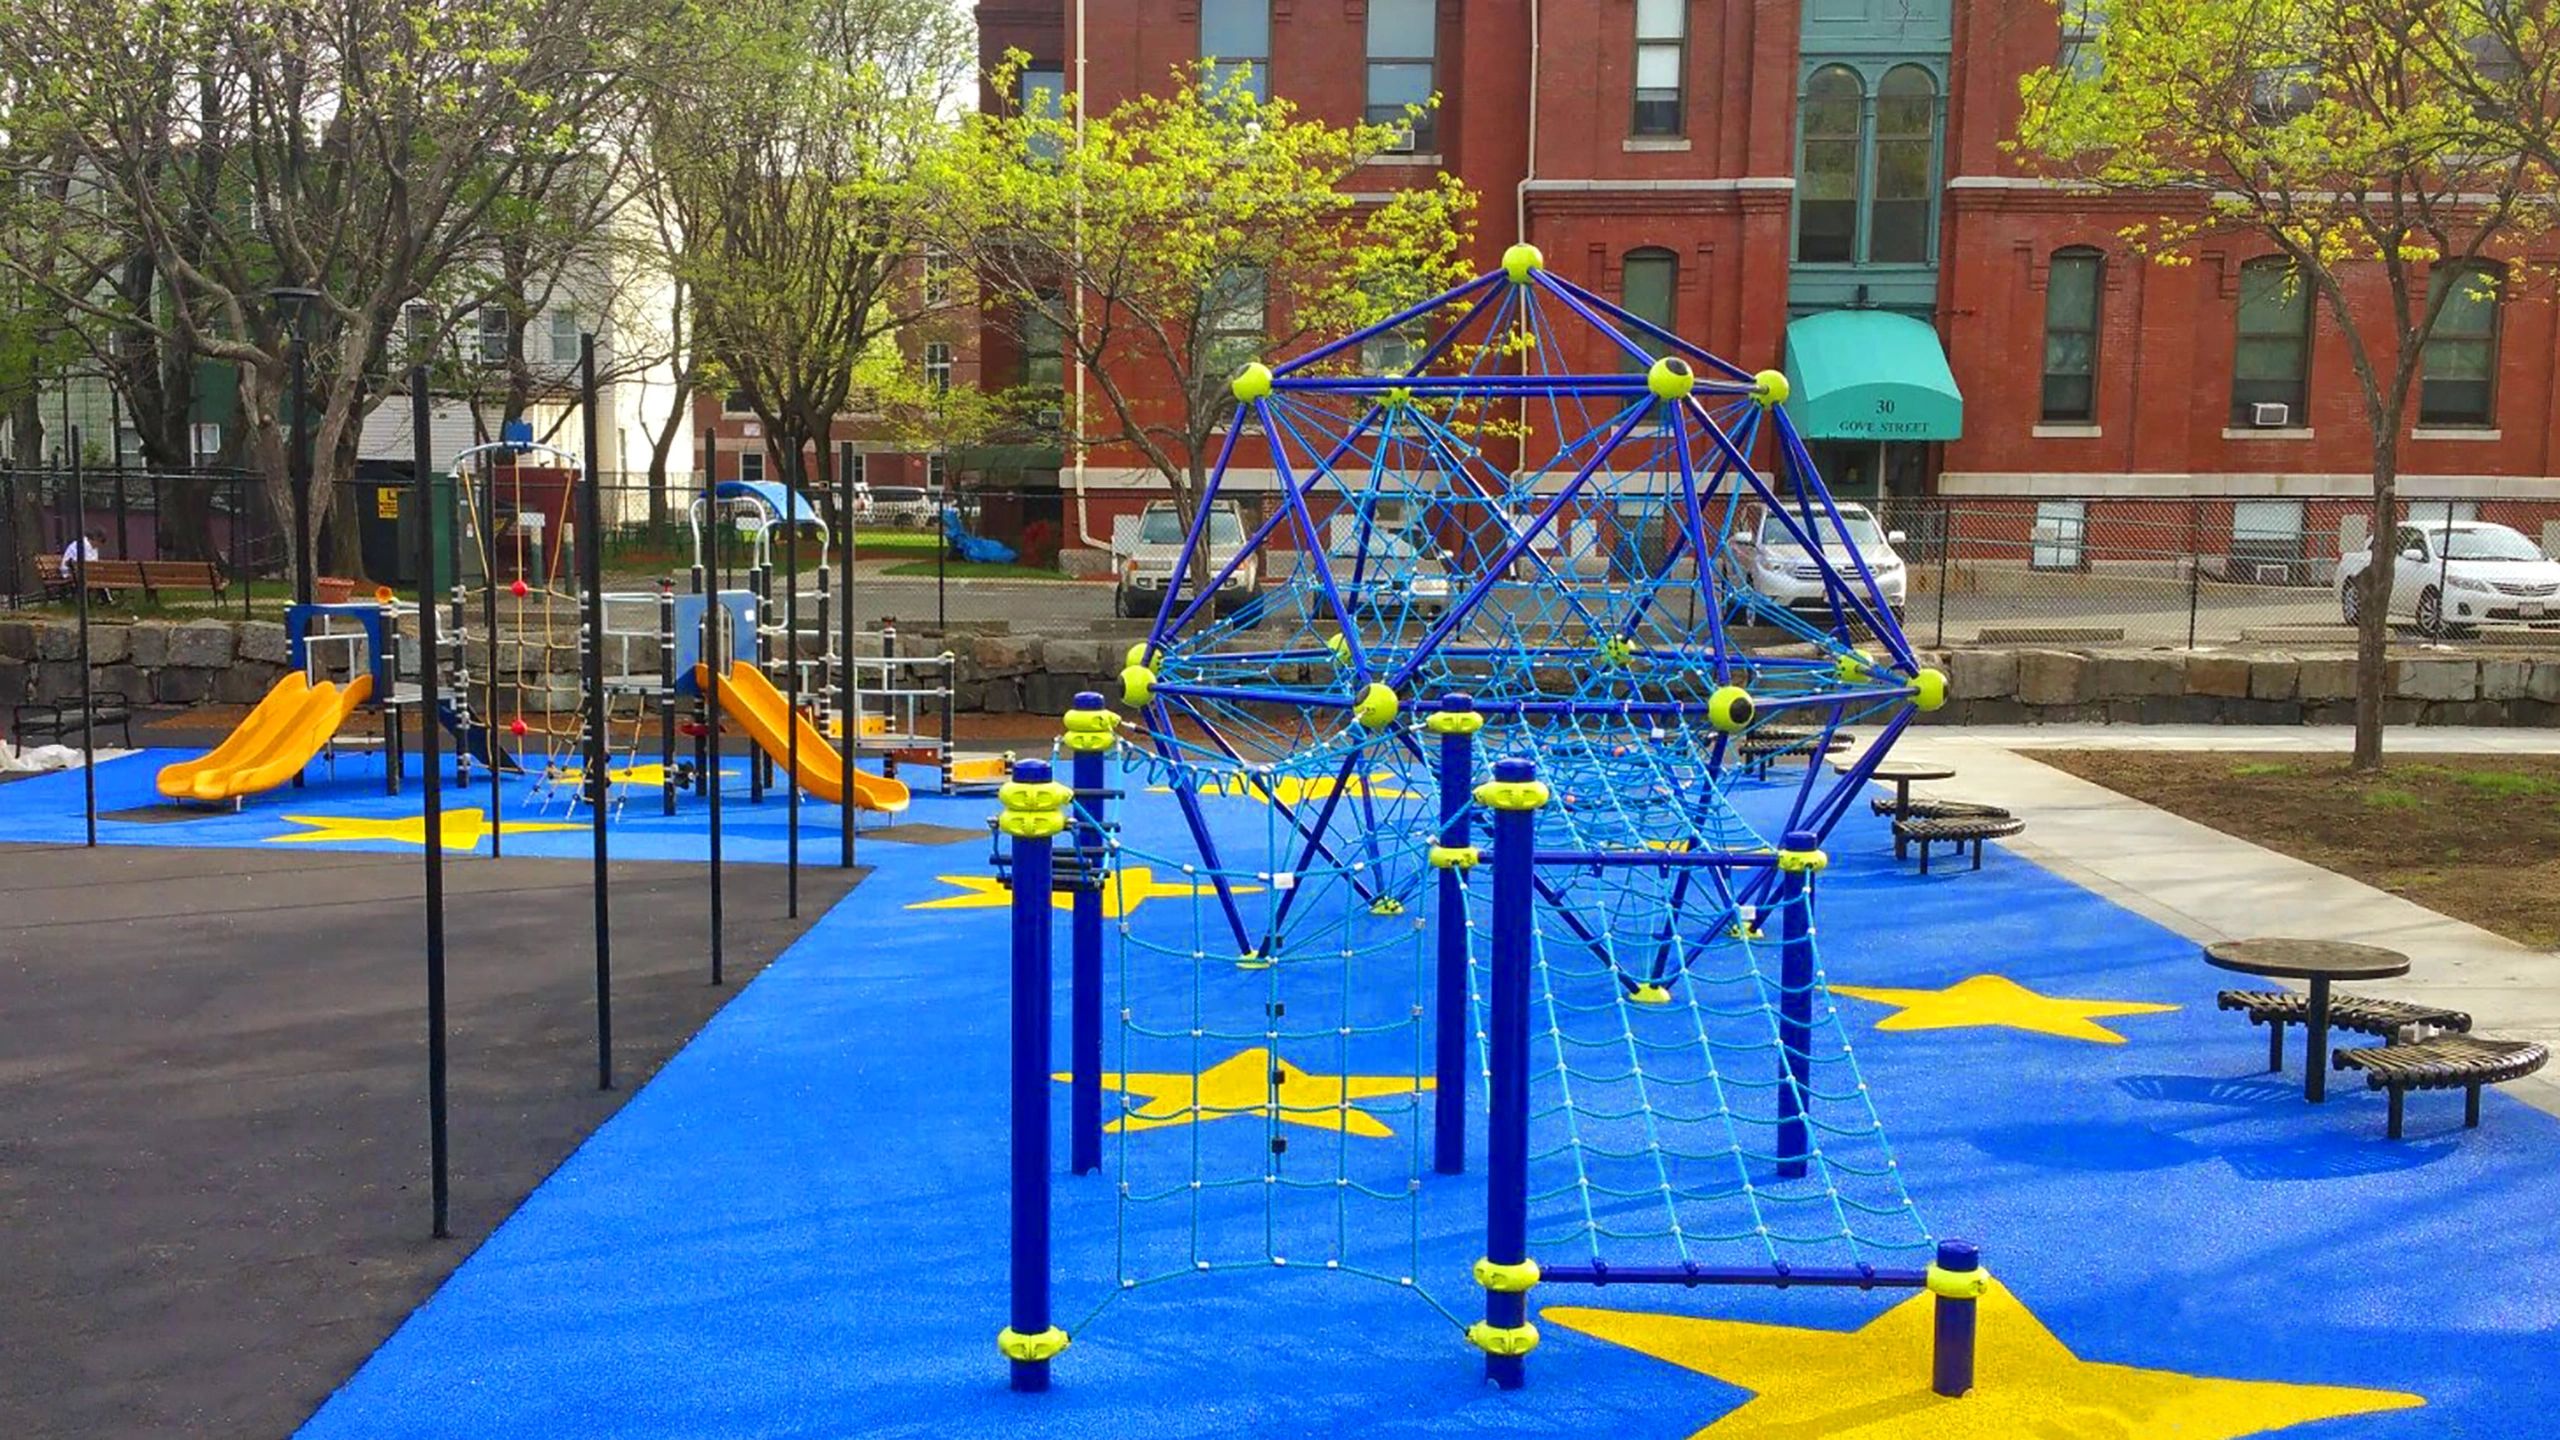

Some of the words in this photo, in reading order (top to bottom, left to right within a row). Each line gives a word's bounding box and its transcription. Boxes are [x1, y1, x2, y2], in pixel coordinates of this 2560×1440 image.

[1876, 400, 1895, 414] 30
[1839, 421, 1873, 432] GOVE
[1879, 422, 1929, 432] STREET
